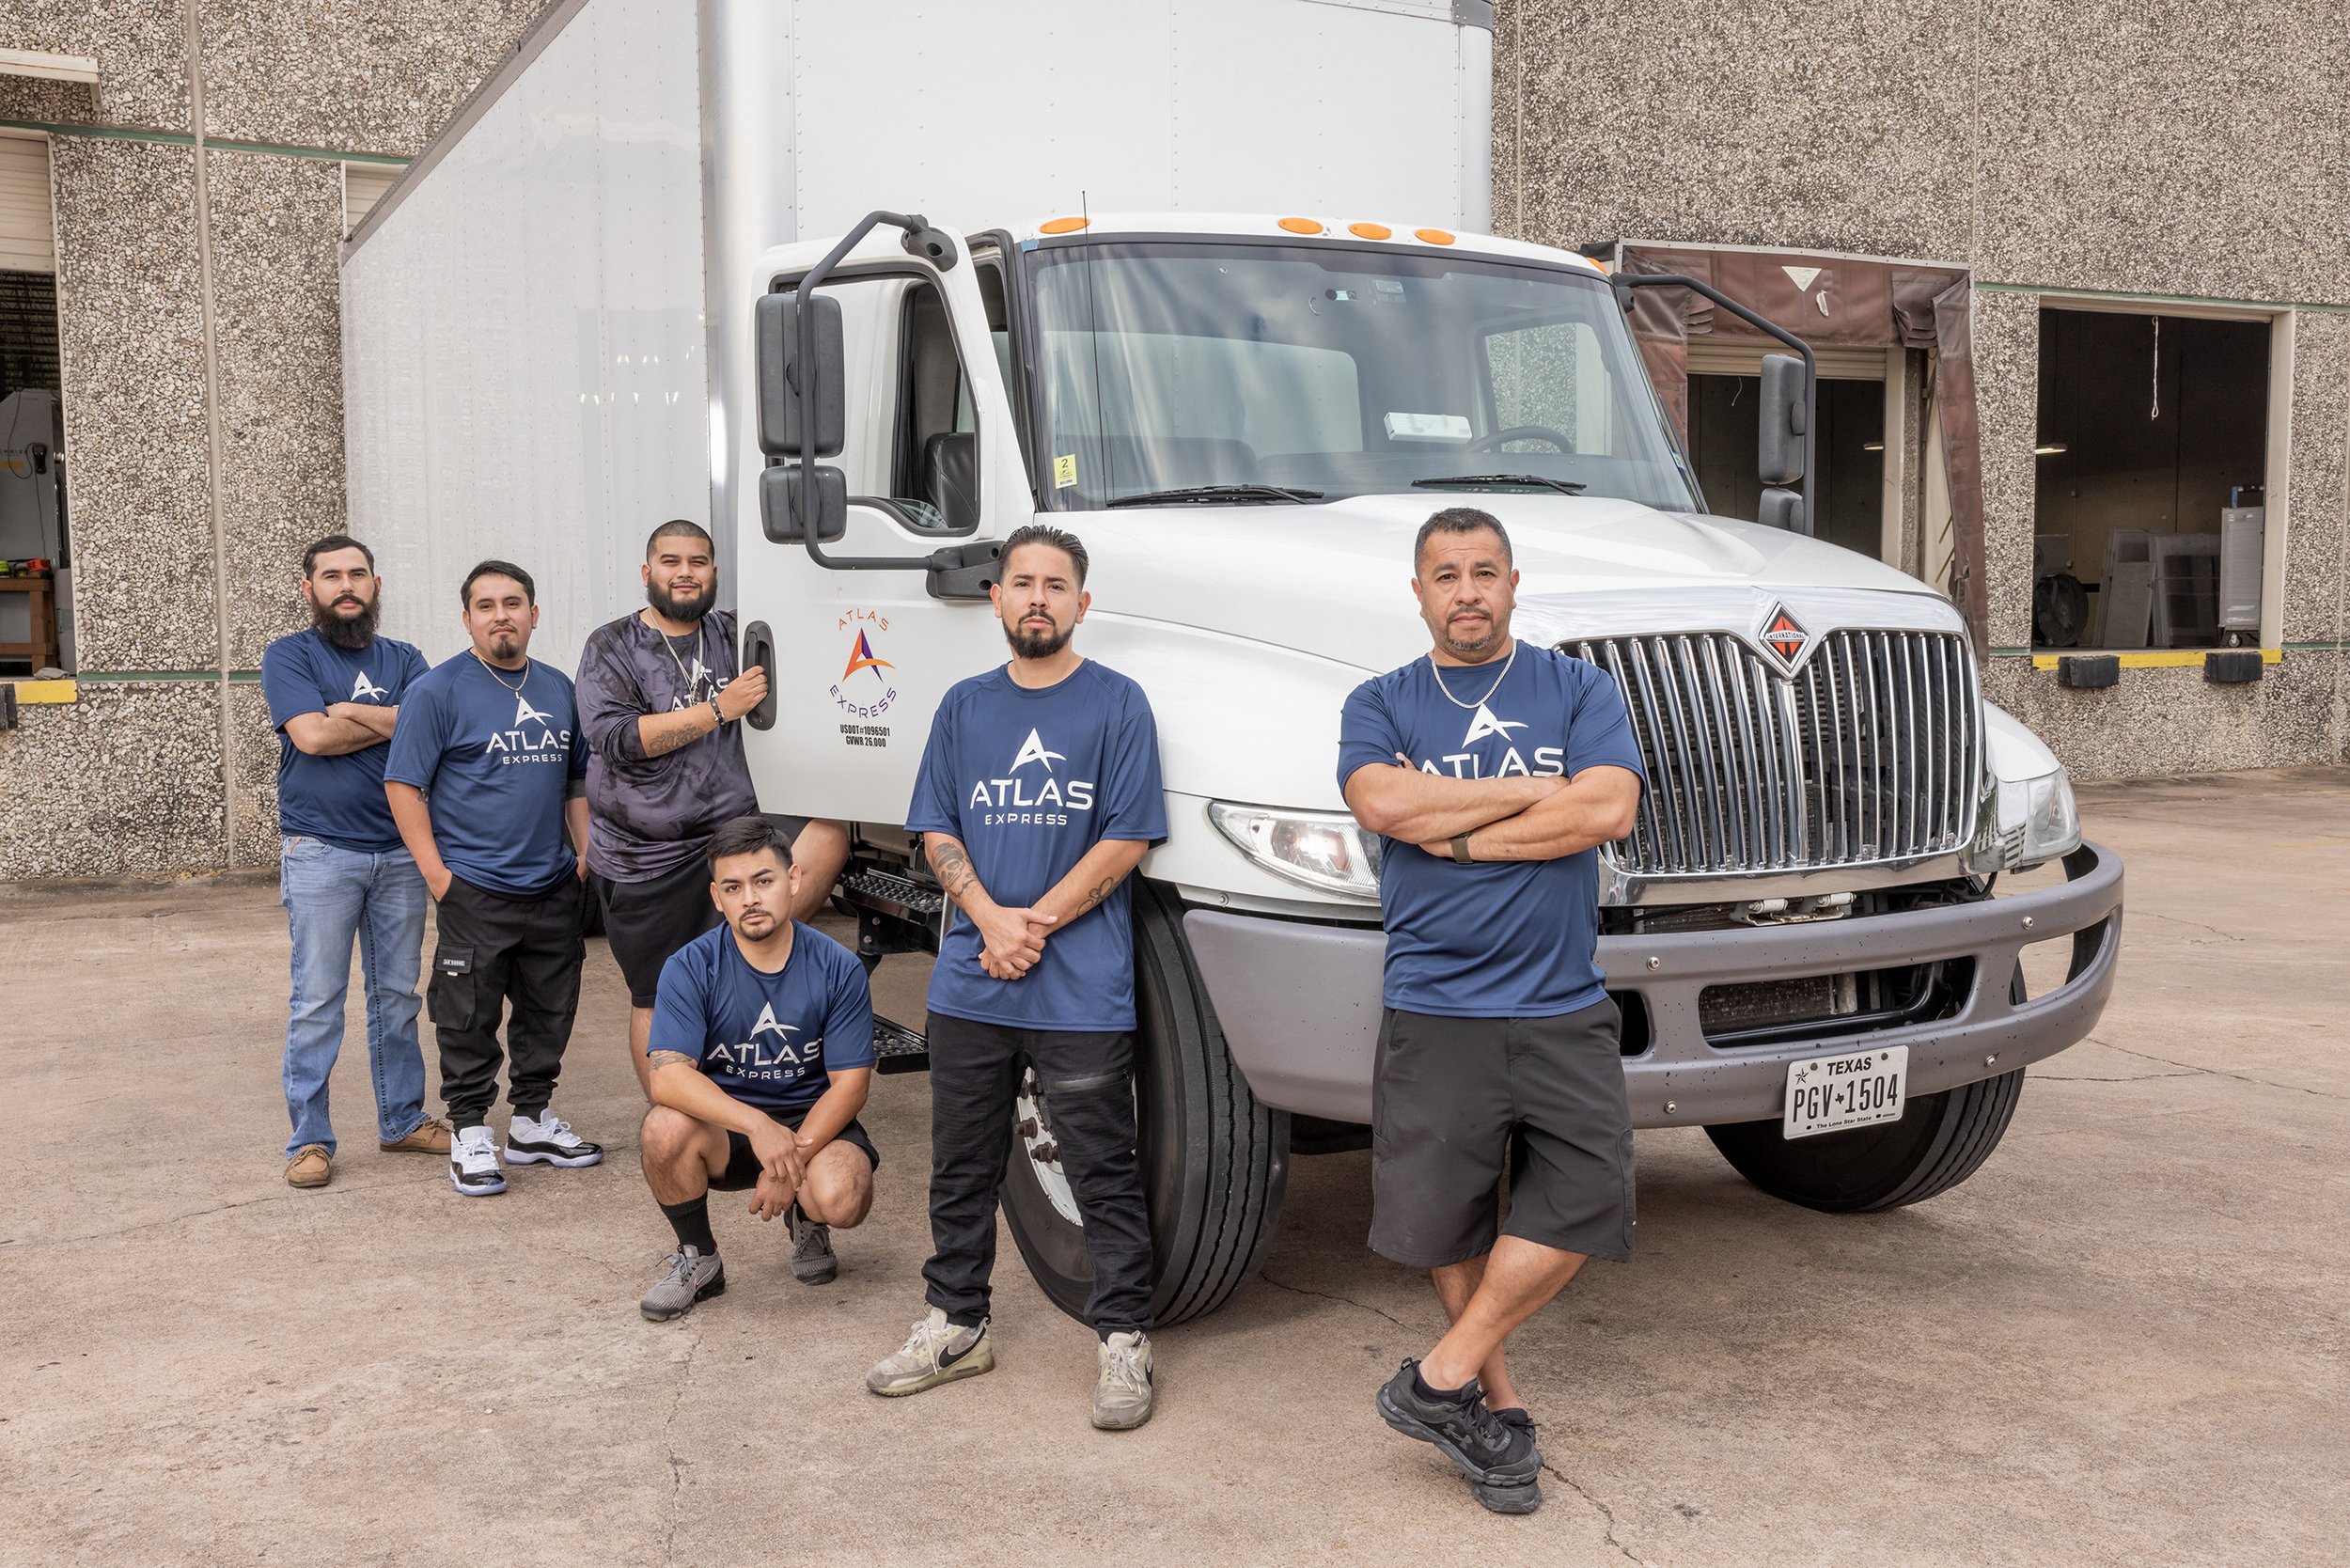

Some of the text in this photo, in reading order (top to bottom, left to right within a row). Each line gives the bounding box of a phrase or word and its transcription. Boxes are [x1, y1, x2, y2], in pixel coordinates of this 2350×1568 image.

[838, 608, 889, 631] ATLAS
[671, 677, 728, 712] ATA
[829, 684, 897, 718] EXPRESS
[485, 729, 572, 753] ATLAS
[839, 724, 890, 737] USDOT#1096501
[845, 735, 864, 745] GVWR
[502, 754, 562, 764] EXPRESS
[969, 777, 1094, 810] ATLAS
[984, 813, 1068, 825] EXPRESS
[707, 1038, 822, 1066] ATLAS
[726, 1064, 806, 1080] EXPRESS
[1826, 1057, 1872, 1076] TEXAS
